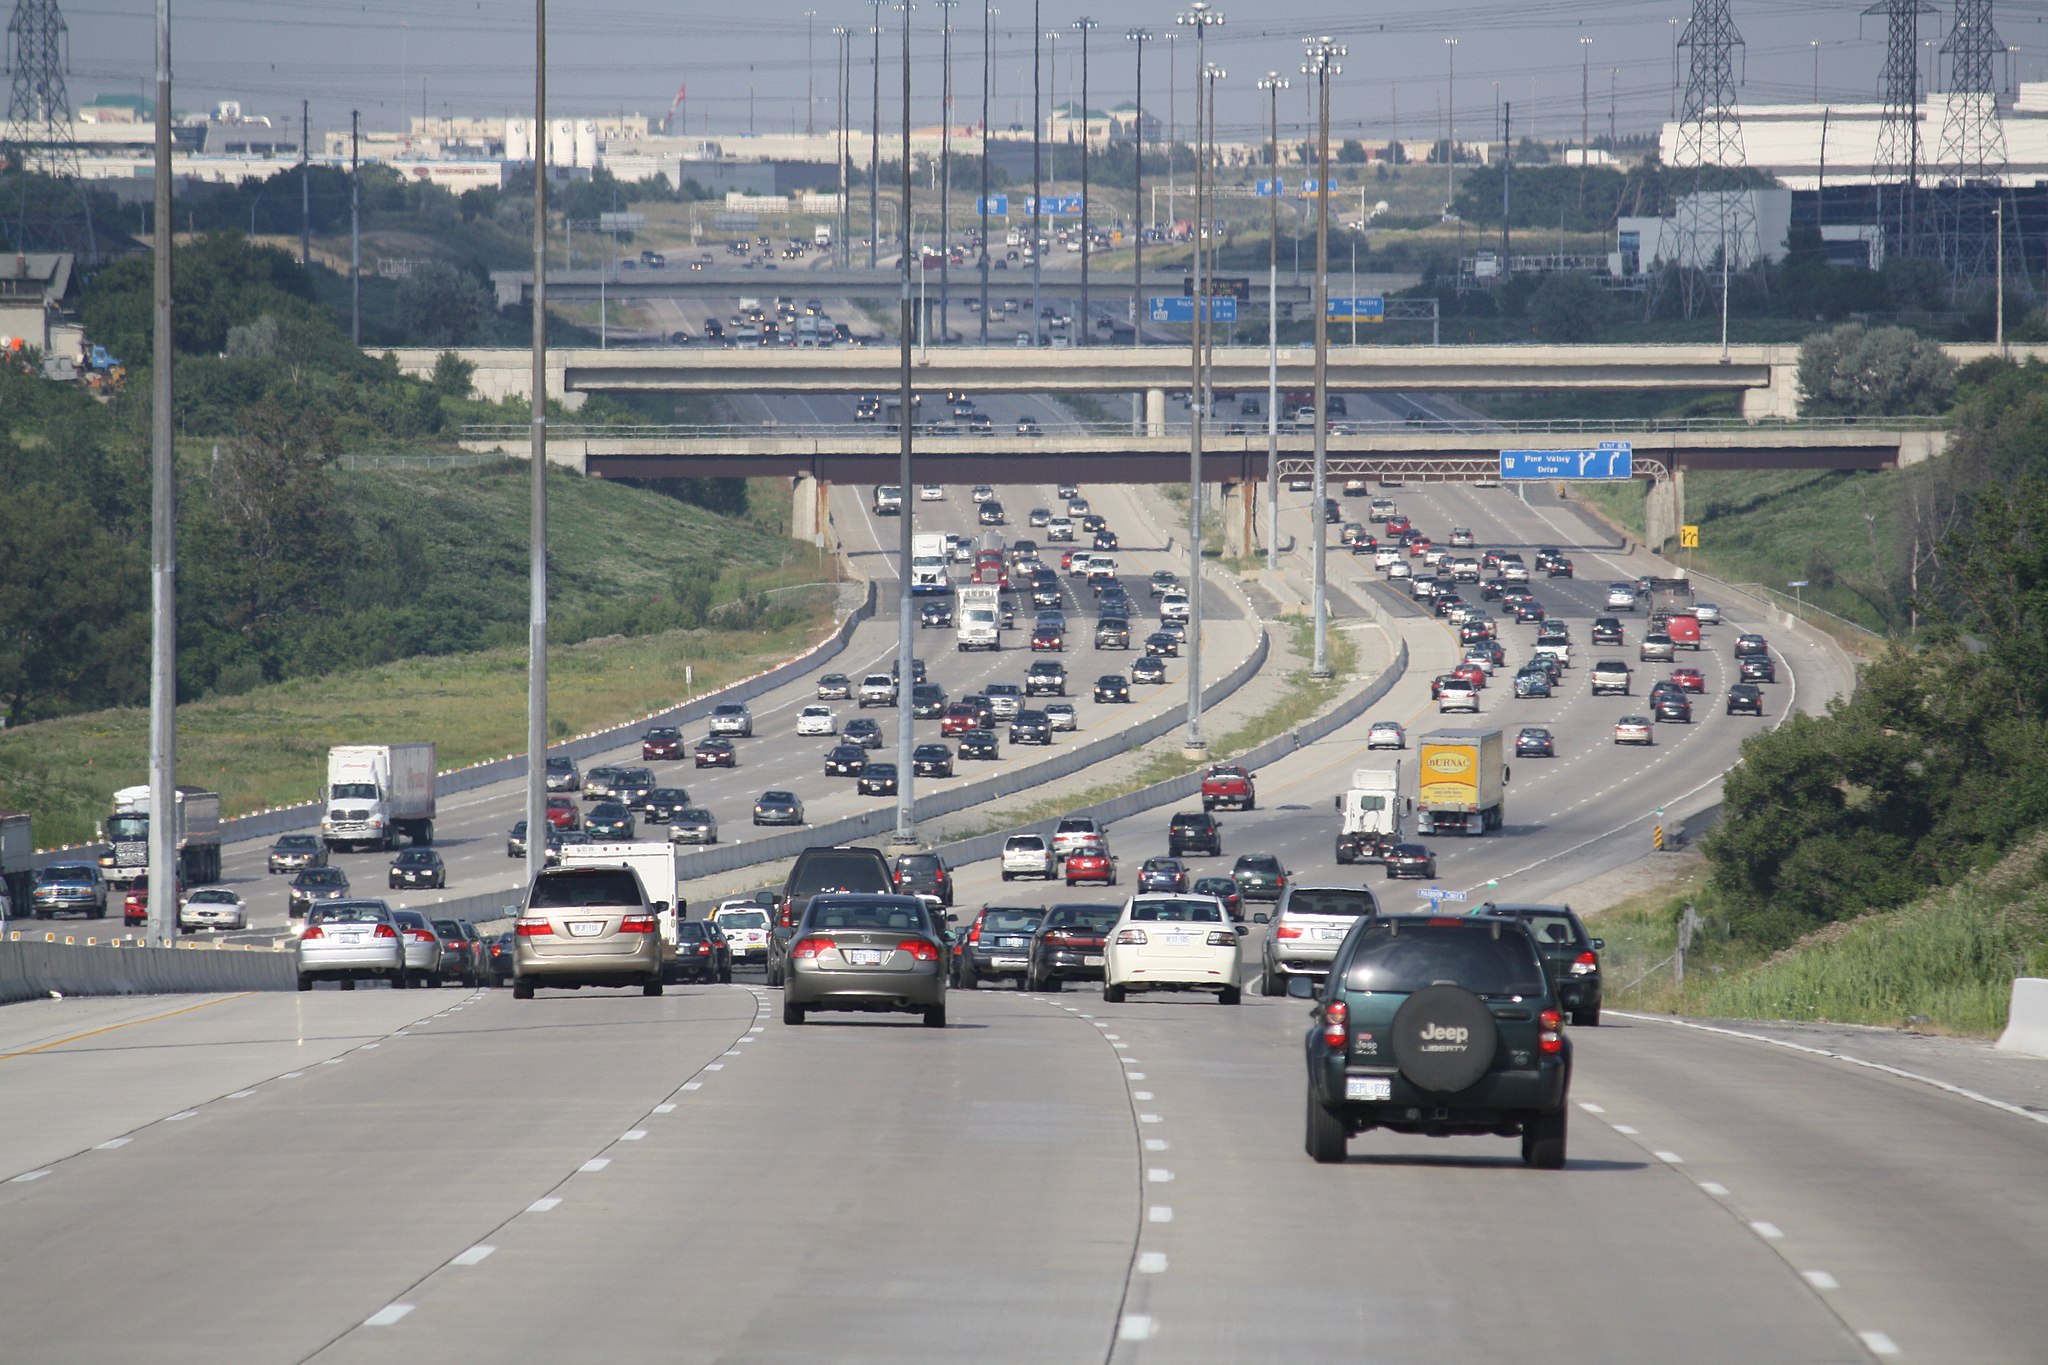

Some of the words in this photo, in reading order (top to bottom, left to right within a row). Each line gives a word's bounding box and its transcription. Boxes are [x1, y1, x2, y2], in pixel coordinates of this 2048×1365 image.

[1524, 455, 1543, 463] Pine
[1546, 455, 1571, 464] Valley
[1420, 1022, 1469, 1043] Jeep
[1355, 1040, 1378, 1050] Jeep
